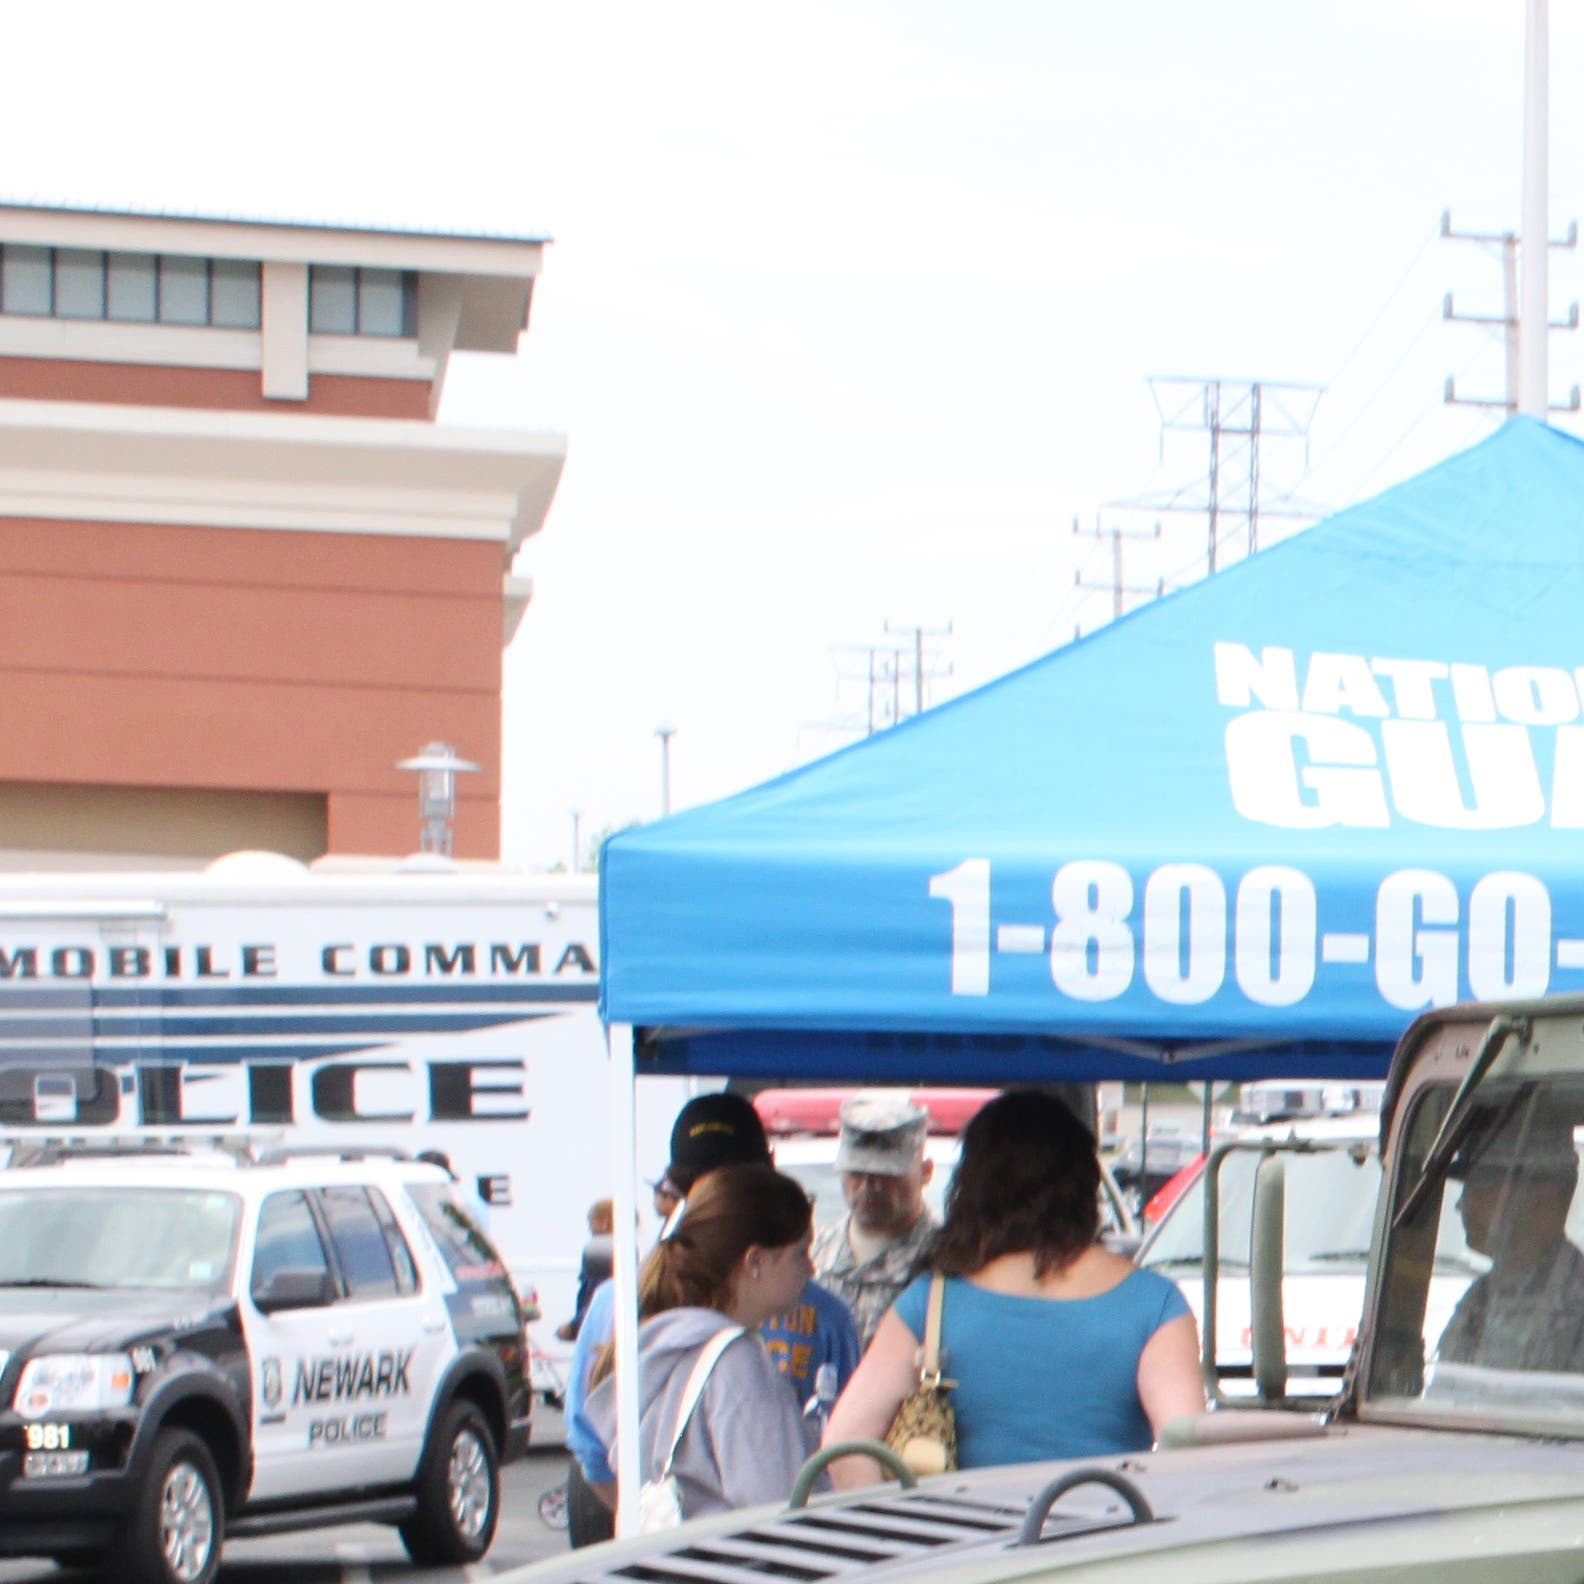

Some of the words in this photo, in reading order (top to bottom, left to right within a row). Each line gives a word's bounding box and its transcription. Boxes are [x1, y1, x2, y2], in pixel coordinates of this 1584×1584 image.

[0, 944, 278, 979] MOBILE
[291, 1348, 417, 1406] NEWARK
[26, 1423, 70, 1450] 981
[308, 1412, 388, 1447] POLICE
